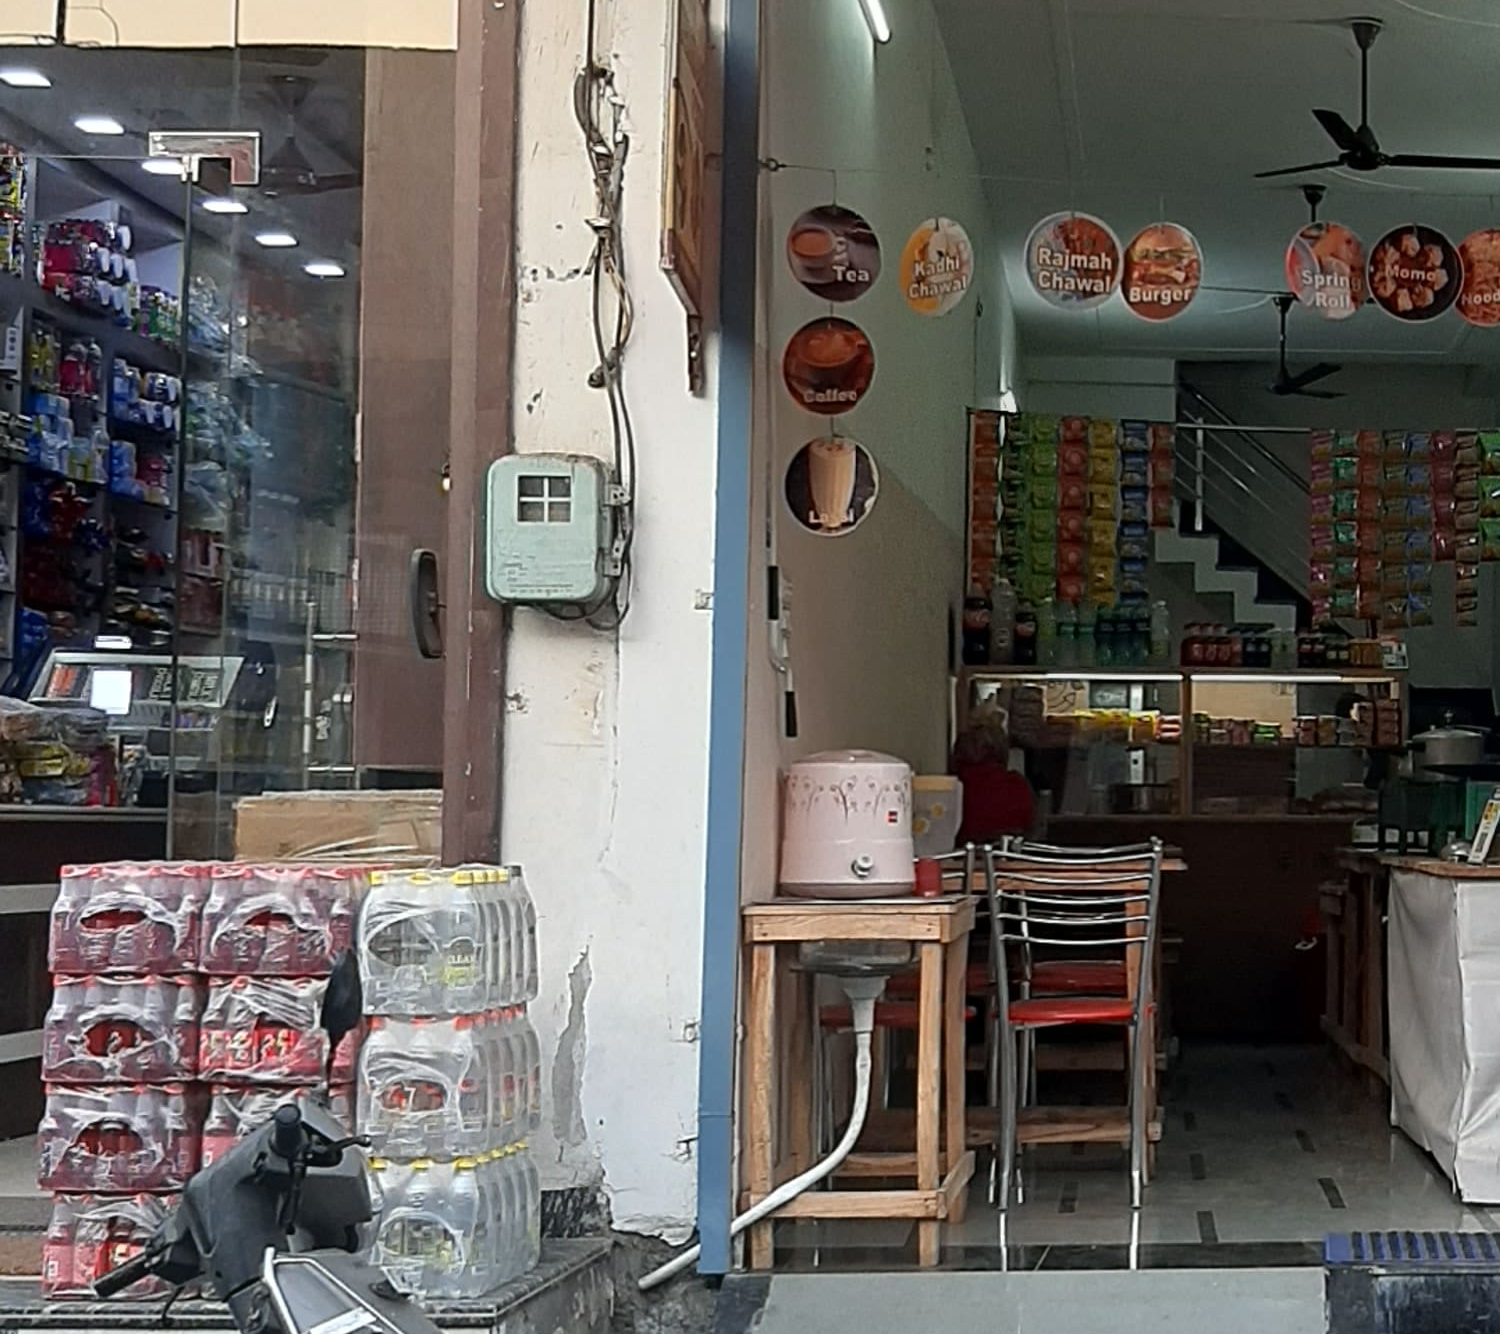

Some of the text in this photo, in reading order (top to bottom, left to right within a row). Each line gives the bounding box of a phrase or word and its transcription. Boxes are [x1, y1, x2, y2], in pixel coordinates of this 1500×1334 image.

[1038, 247, 1112, 272] Rajmah
[832, 265, 870, 283] Tea
[1038, 271, 1111, 294] Chawal
[1129, 286, 1192, 306] Burger
